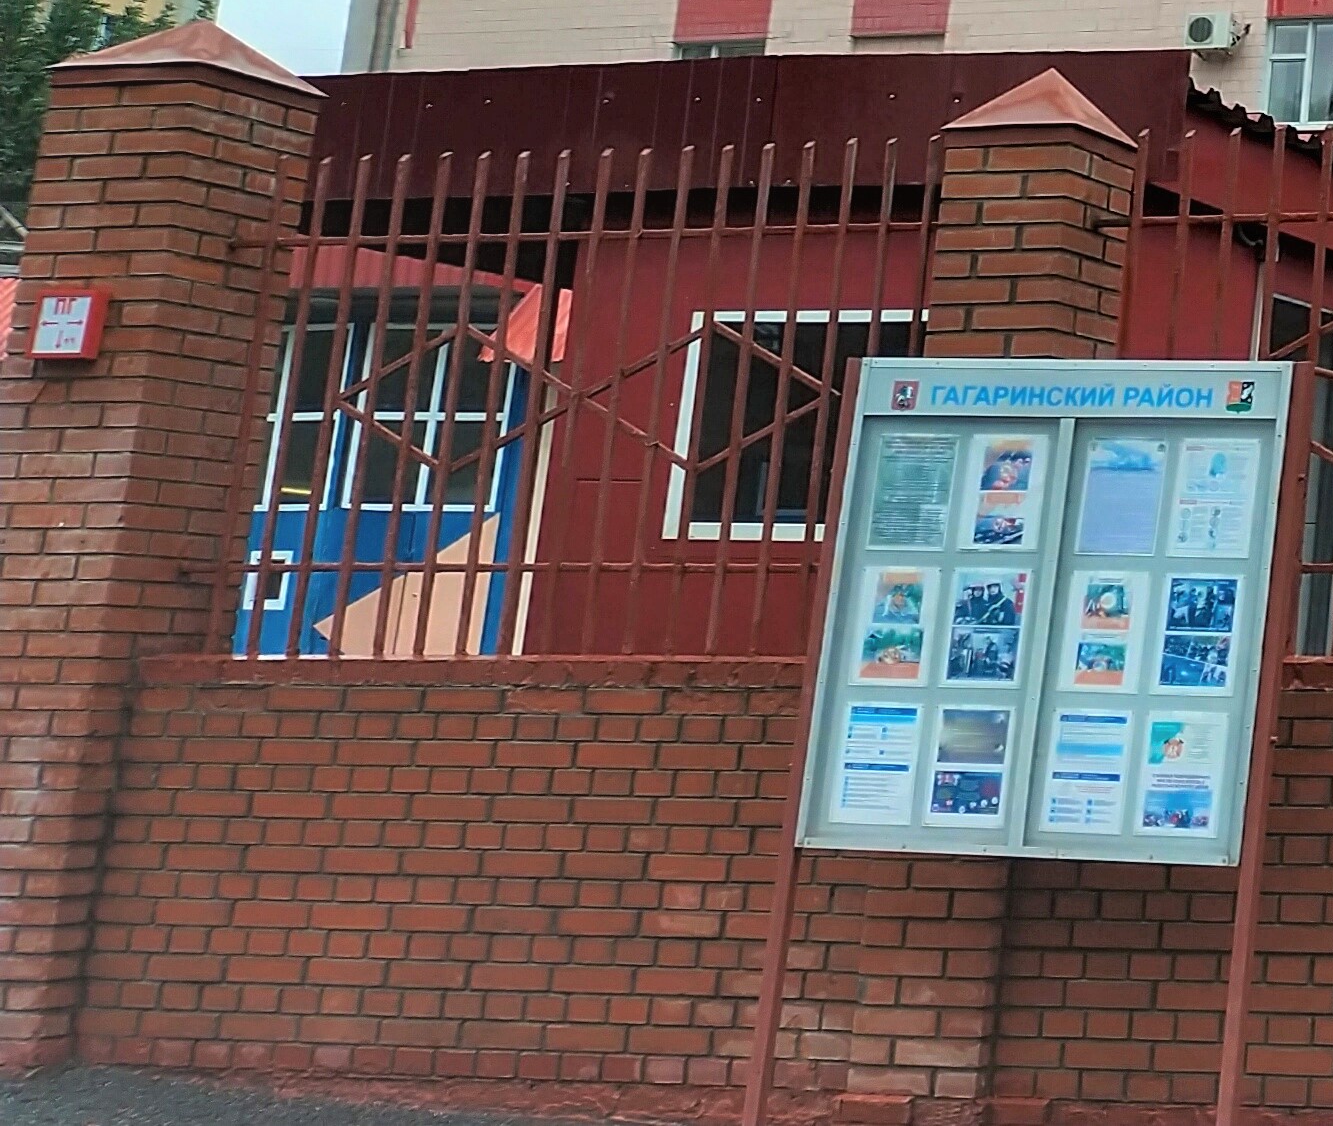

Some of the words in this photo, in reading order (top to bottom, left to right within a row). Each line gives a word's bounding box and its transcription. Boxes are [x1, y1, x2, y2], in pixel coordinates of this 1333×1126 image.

[53, 297, 77, 315] ПГ
[929, 382, 1115, 408] ГАГАРИНСКИЙ
[1122, 381, 1214, 409] РАЙОН
